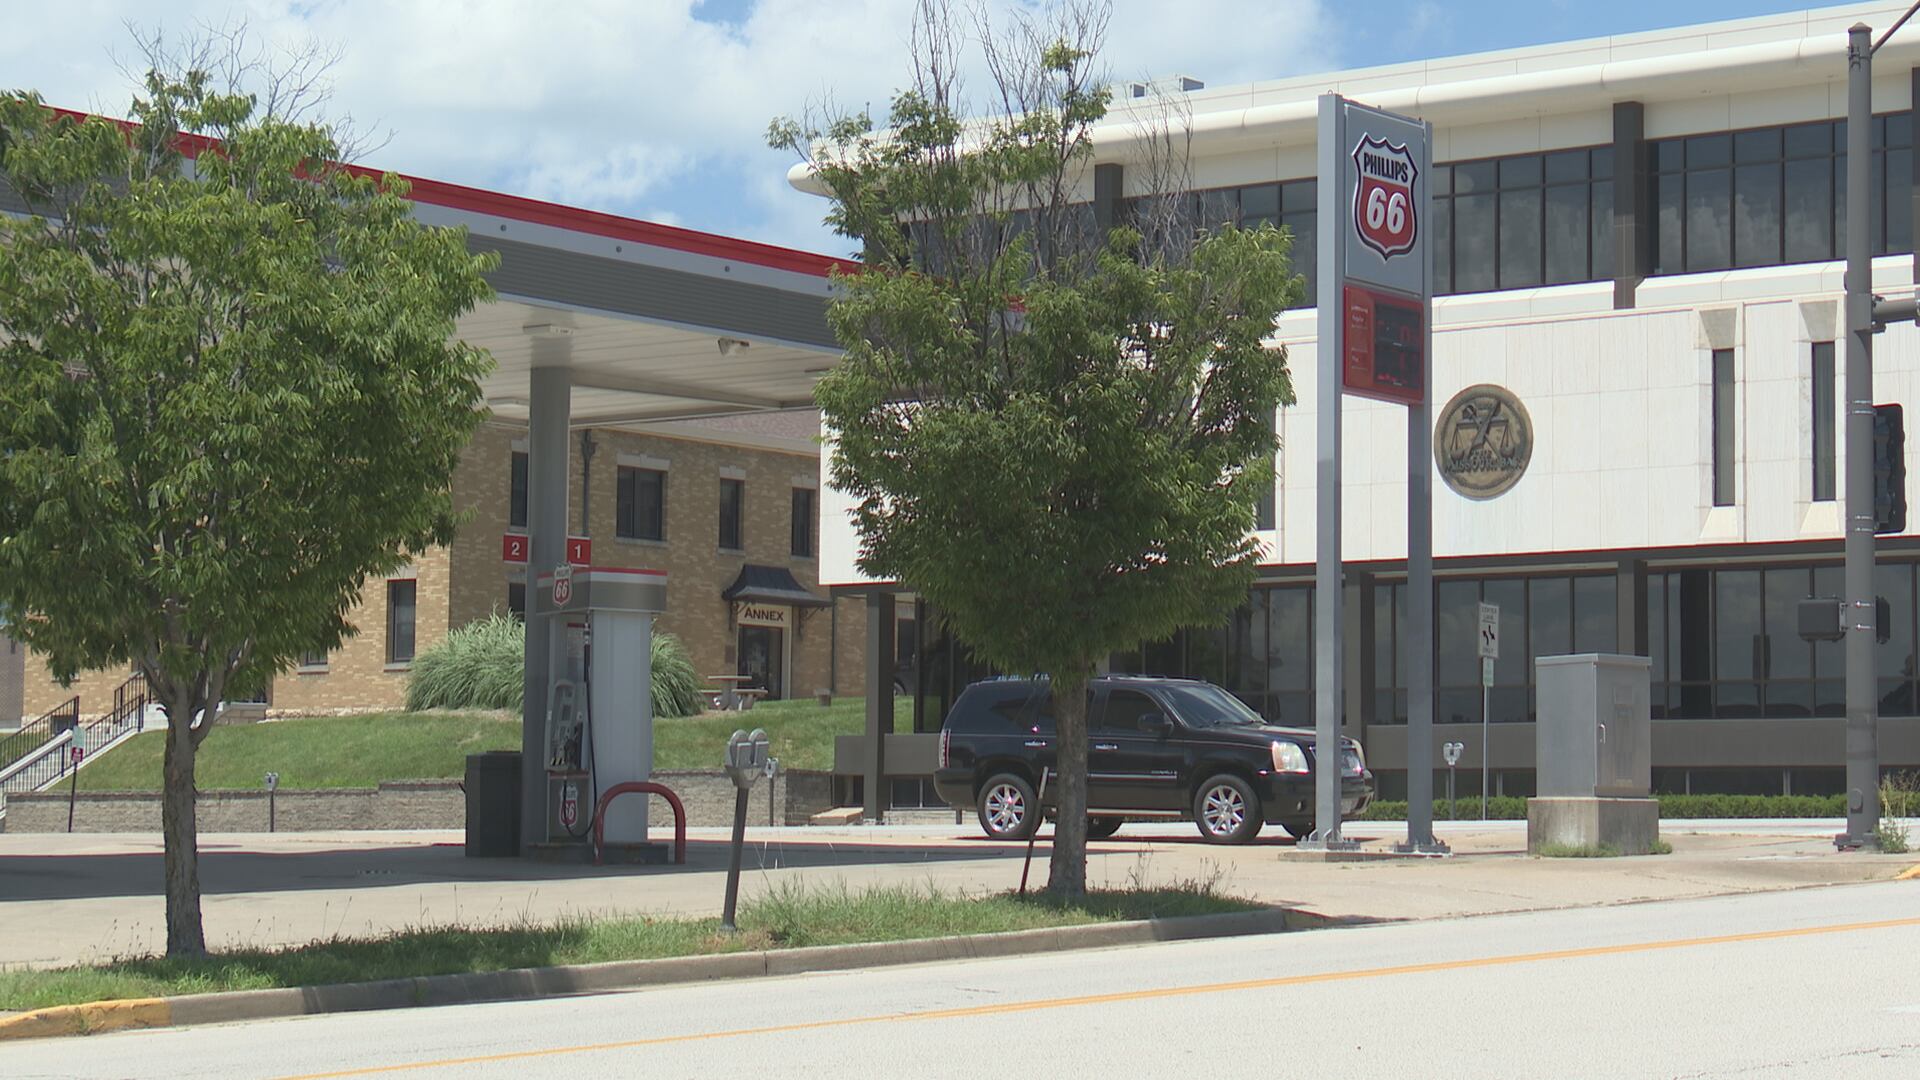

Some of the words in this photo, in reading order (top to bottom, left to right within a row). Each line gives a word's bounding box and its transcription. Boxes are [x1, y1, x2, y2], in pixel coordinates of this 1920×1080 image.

[1363, 152, 1408, 182] PHILLIPS
[1366, 186, 1407, 234] 66
[511, 541, 521, 556] 2
[574, 544, 582, 559] 1
[556, 581, 568, 599] 66
[744, 606, 784, 621] ANNEX
